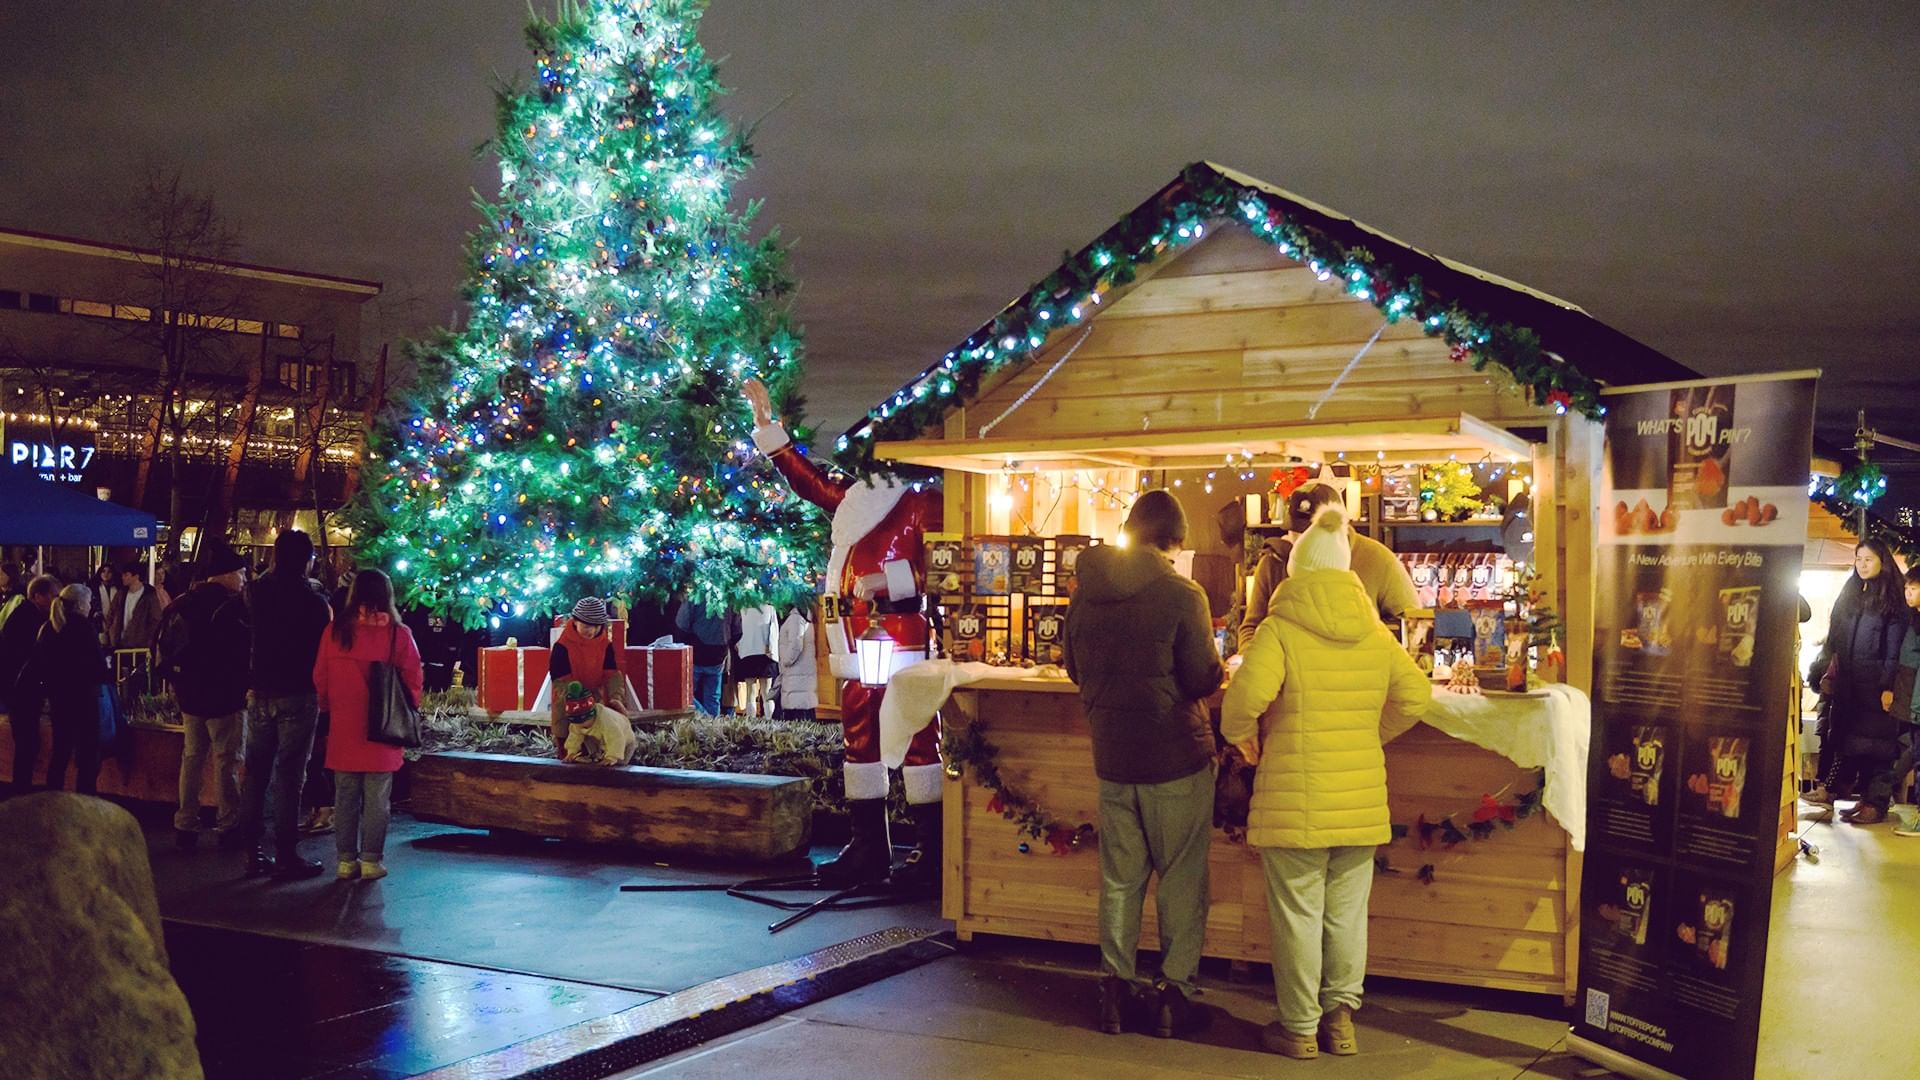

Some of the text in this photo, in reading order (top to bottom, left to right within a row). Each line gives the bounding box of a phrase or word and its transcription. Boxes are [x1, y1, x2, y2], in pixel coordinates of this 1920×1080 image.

[1637, 418, 1684, 436] WHAT'S
[80, 446, 96, 470] 7
[67, 472, 83, 483] bar
[1637, 553, 1659, 566] New
[1657, 553, 1698, 567] Adveure
[1717, 551, 1745, 568] Every
